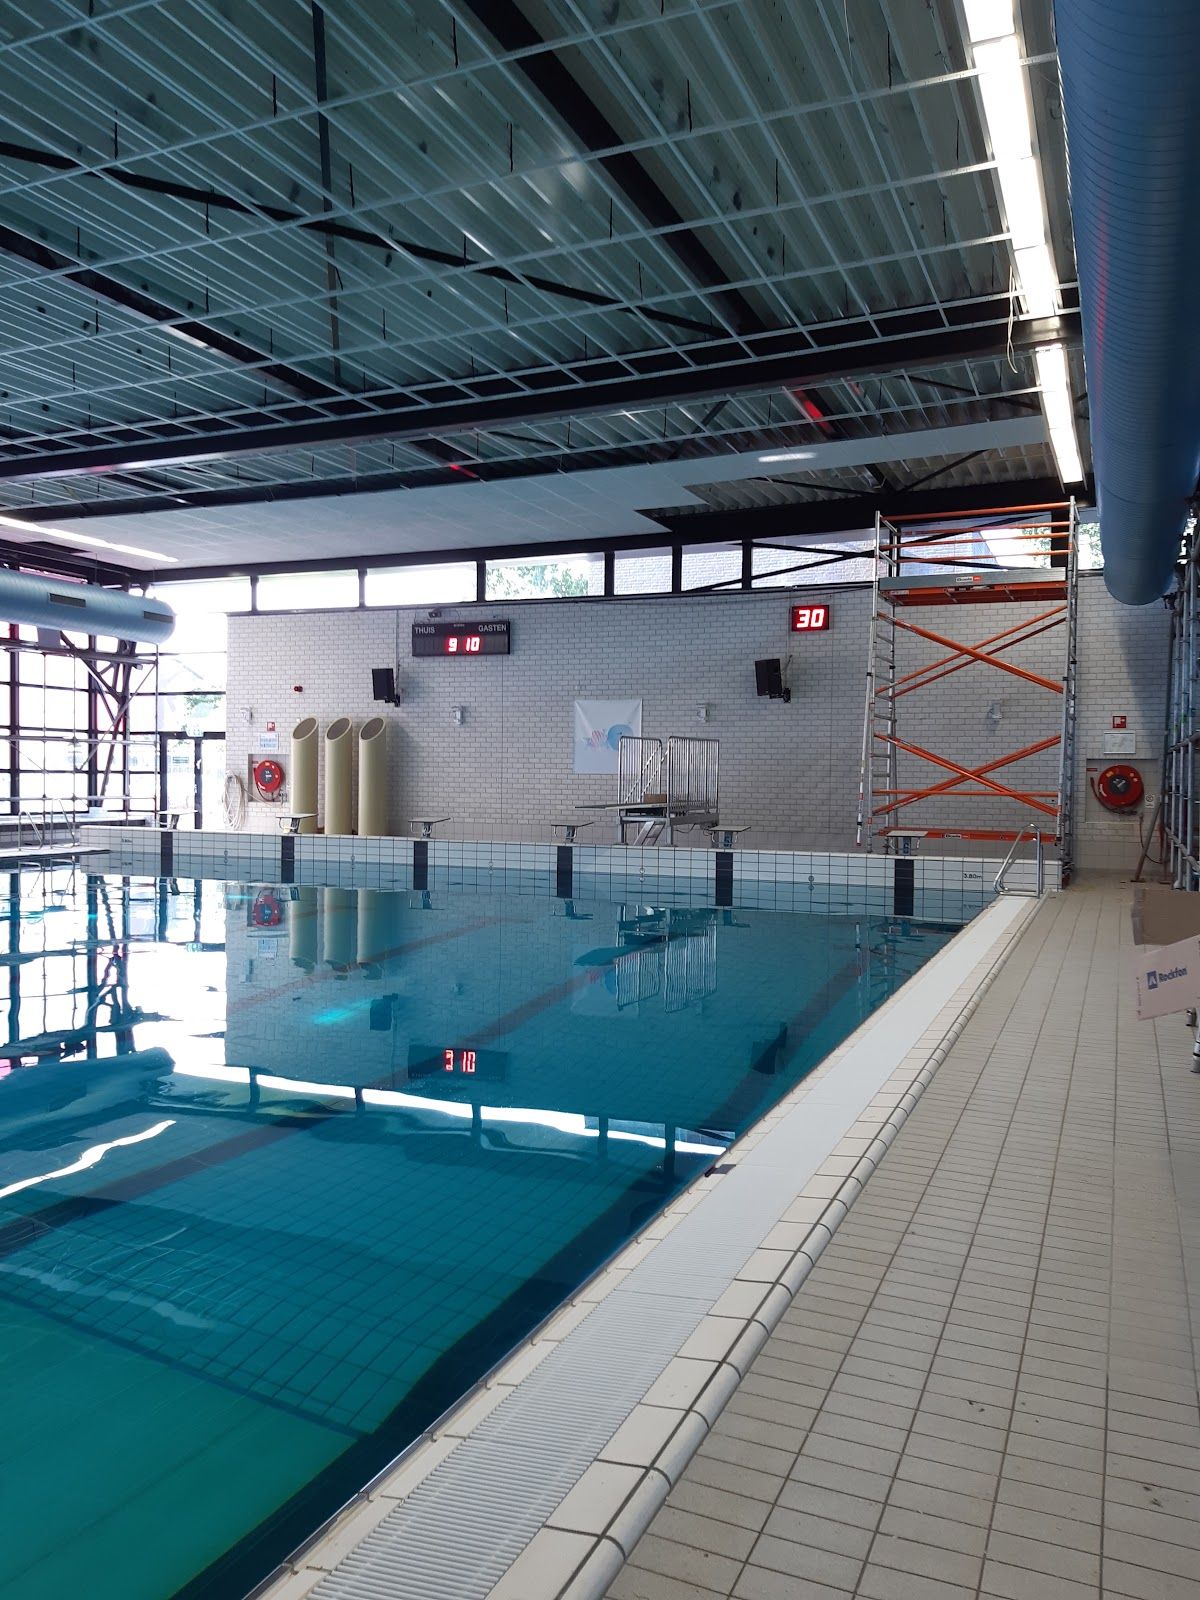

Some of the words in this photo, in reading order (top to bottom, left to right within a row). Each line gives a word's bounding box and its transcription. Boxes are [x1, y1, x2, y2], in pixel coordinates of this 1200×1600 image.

[796, 608, 825, 628] 30
[414, 626, 436, 635] THUIS
[478, 623, 507, 632] GASTEN
[448, 637, 458, 652] 9
[465, 637, 480, 652] 10
[1158, 966, 1188, 983] Rockfon
